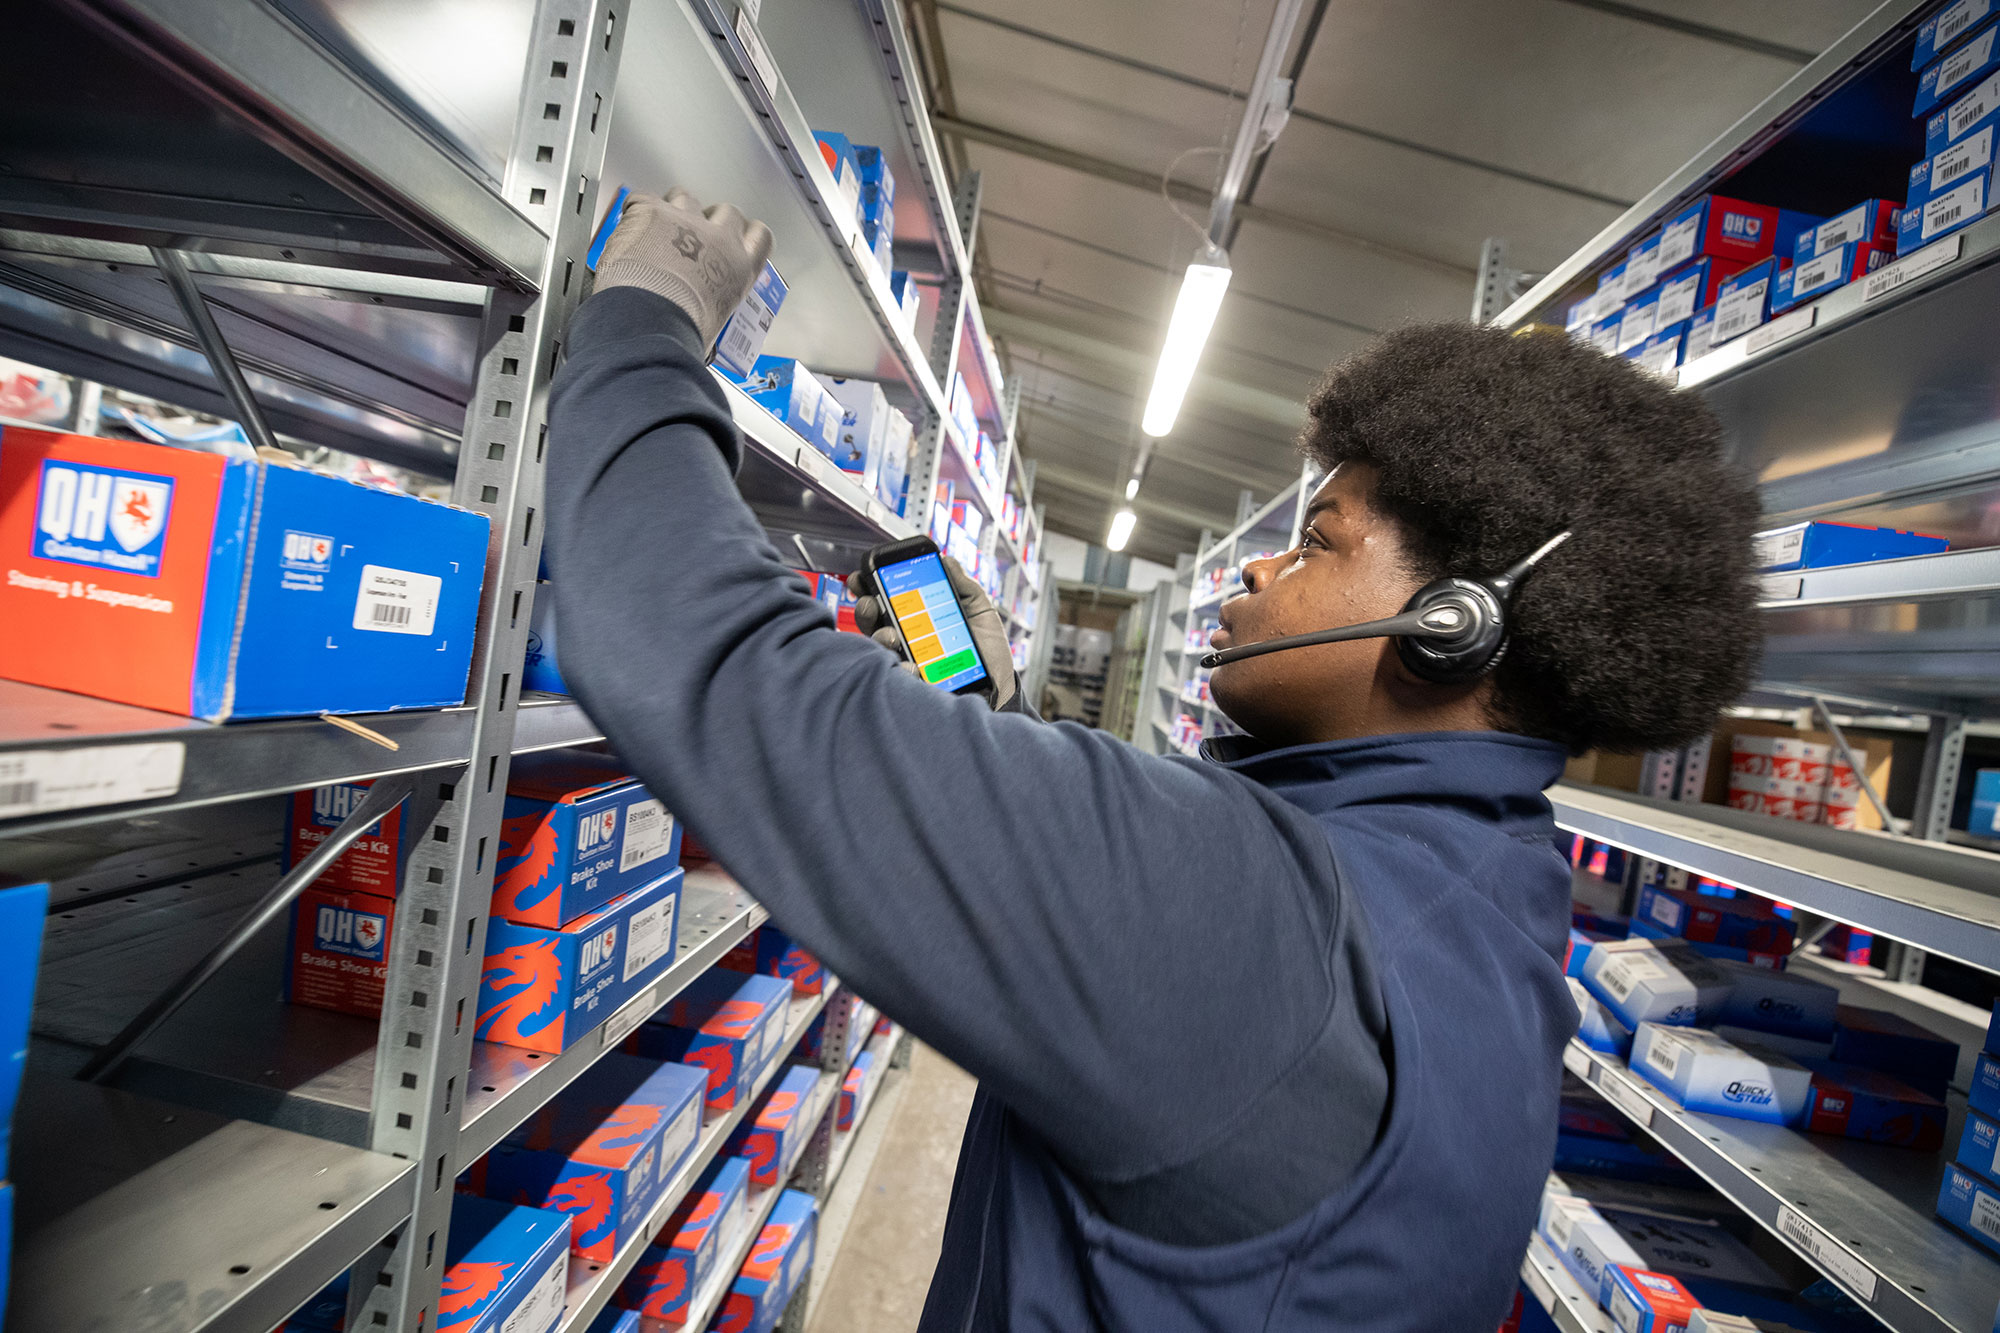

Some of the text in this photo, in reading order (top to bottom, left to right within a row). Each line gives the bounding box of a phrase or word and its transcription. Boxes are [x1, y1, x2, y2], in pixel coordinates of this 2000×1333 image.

[1724, 212, 1745, 233] QH
[40, 466, 113, 542] QH
[283, 533, 312, 561] QH
[315, 785, 351, 818] QH
[299, 828, 328, 842] Brak
[371, 841, 390, 855] Kit
[578, 812, 602, 852] QH
[571, 858, 615, 885] Brake Shoe
[585, 876, 599, 892] Kit
[318, 907, 354, 944] QH
[301, 952, 337, 969] Brake
[340, 959, 371, 976] Shoe
[580, 933, 603, 976] QH
[573, 974, 615, 1010] Brake Shoe
[1727, 1081, 1768, 1095] QUICK
